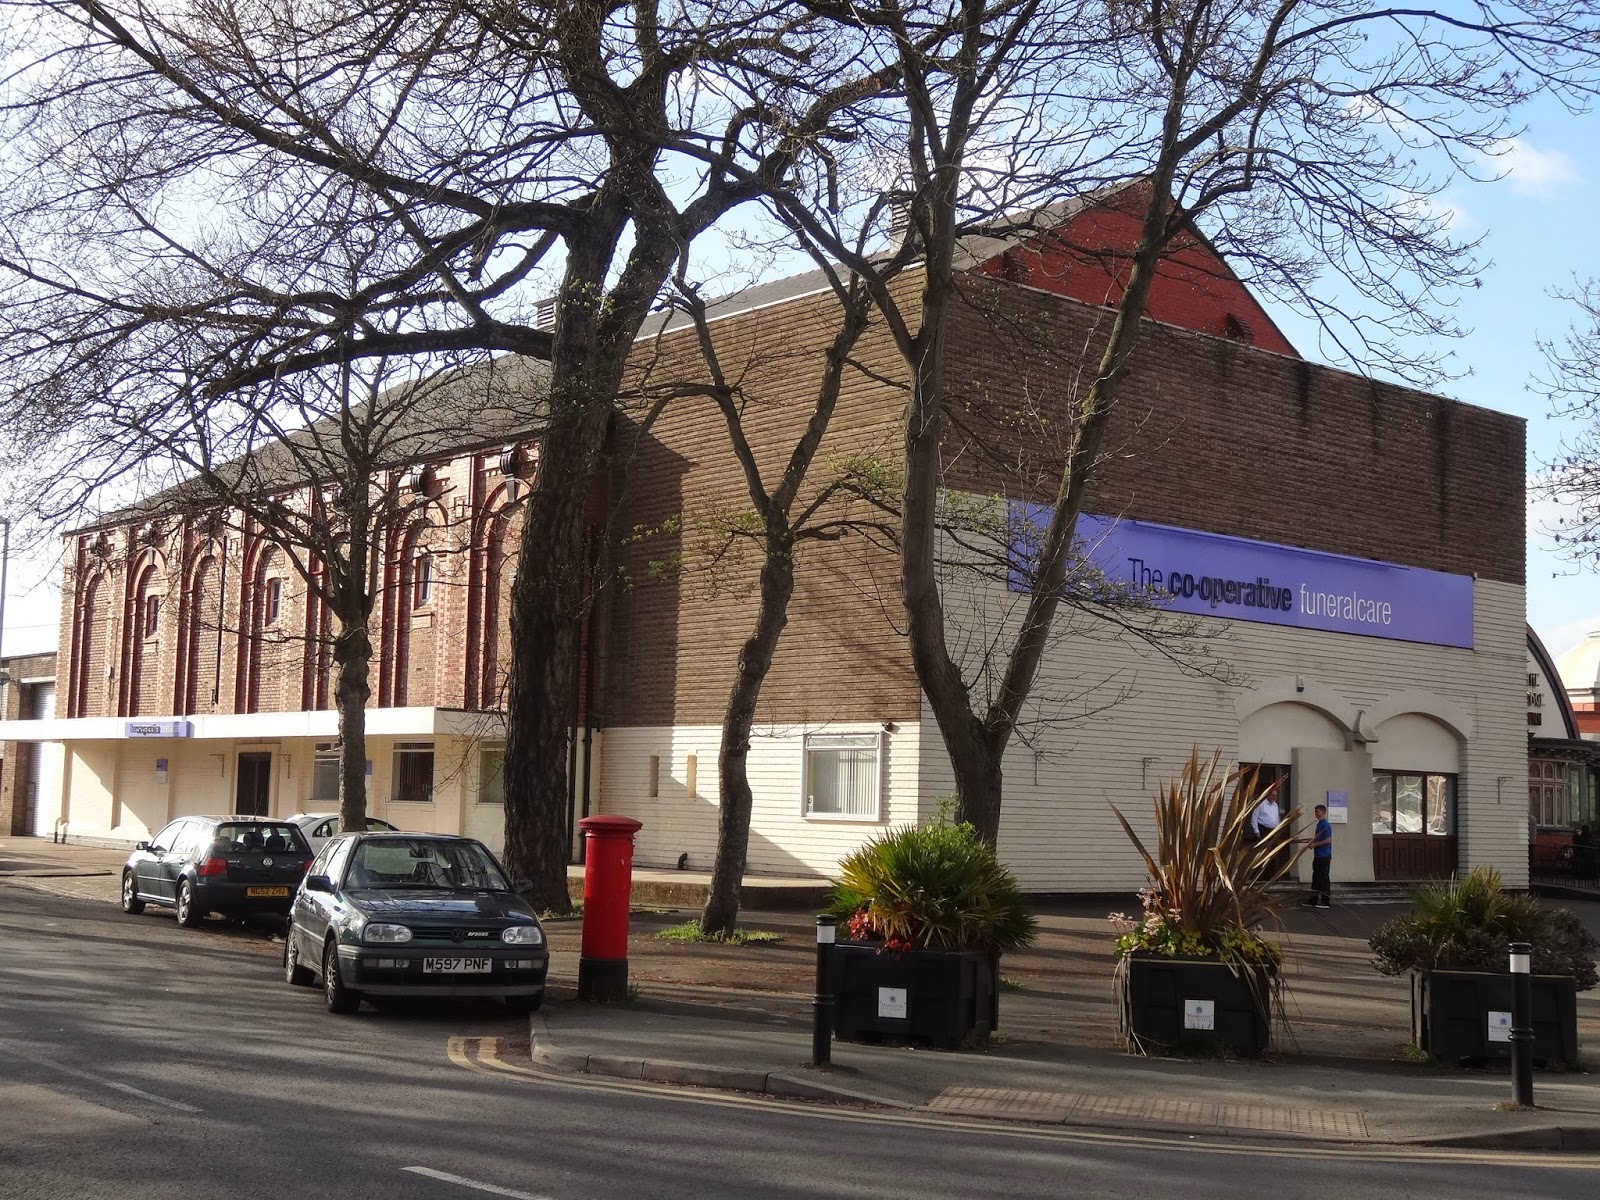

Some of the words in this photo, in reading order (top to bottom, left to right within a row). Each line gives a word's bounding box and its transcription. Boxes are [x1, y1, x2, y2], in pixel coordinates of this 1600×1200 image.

[1127, 557, 1164, 593] The
[1168, 570, 1293, 612] co-operative
[1299, 583, 1392, 625] funeralcare
[250, 887, 270, 895] NG52
[271, 887, 286, 895] ZHU
[425, 958, 461, 970] M597
[463, 958, 491, 970] PNF
